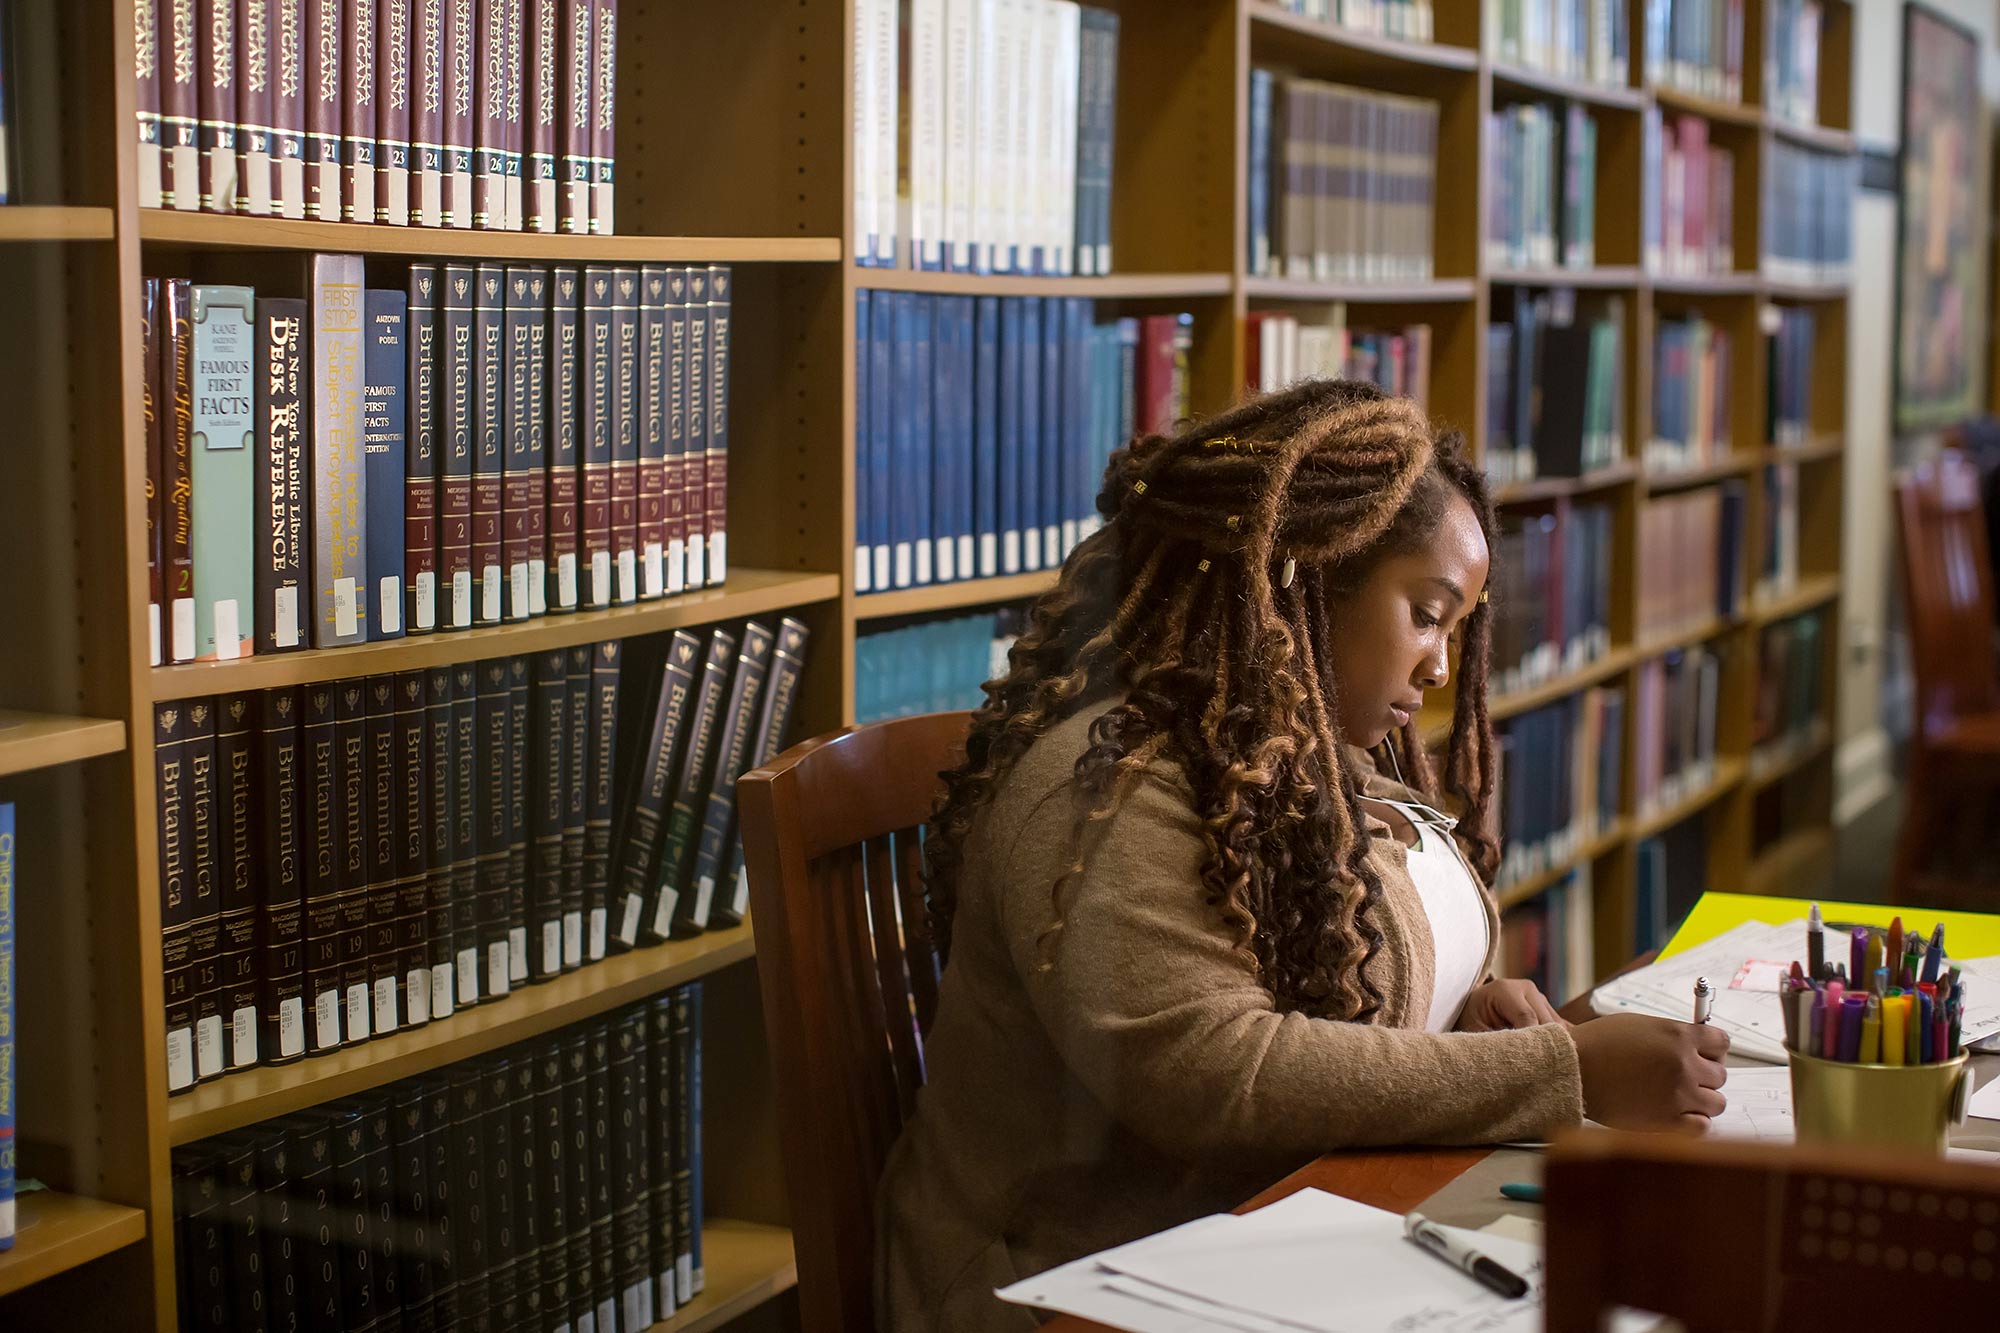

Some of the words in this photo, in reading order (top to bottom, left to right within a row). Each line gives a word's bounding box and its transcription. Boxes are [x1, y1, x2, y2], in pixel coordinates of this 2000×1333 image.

[283, 139, 298, 156] 20
[323, 143, 336, 158] 21
[357, 147, 371, 162] 22
[392, 150, 405, 165] 23
[426, 153, 438, 167] 24
[456, 155, 468, 170] 25
[490, 157, 502, 172] 26
[506, 160, 518, 175] 27
[541, 163, 554, 178] 28
[574, 165, 587, 179] 29
[323, 290, 358, 307] FIRST
[324, 309, 358, 326] STOP
[288, 318, 299, 352] The
[200, 360, 249, 374] FAMOUS
[270, 317, 290, 396] DESK
[207, 378, 242, 392] FIRST
[288, 356, 299, 396] New
[325, 339, 342, 419] Subject
[514, 324, 528, 454] Britannica
[530, 324, 545, 452] Britannica
[561, 324, 576, 450] Britannica
[594, 323, 608, 448] Britannica
[620, 322, 635, 446] Britannica
[650, 321, 664, 443] Britannica
[671, 321, 685, 441] Britannica
[690, 319, 705, 438] Britannica
[713, 317, 728, 435] Britannica
[364, 386, 397, 396] FAMOUS
[419, 324, 433, 460] Britannica
[455, 324, 469, 458] Britannica
[485, 324, 499, 457] Britannica
[200, 397, 250, 415] FACTS
[364, 402, 387, 412] FIRST
[288, 400, 300, 442] York
[364, 418, 390, 427] FACTS
[289, 446, 301, 500] Public
[270, 405, 290, 571] REFERENCE
[345, 472, 359, 528] Index
[171, 476, 192, 545] Reading
[563, 510, 570, 526] 6
[597, 507, 603, 523] 7
[623, 504, 630, 519] 8
[651, 501, 658, 517] 9
[671, 498, 681, 513] 10
[457, 522, 465, 538] 2
[488, 519, 494, 535] 3
[516, 517, 523, 532] 4
[533, 513, 540, 529] 5
[289, 504, 301, 569] Library
[347, 535, 360, 557] to
[177, 569, 189, 591] 2
[571, 691, 587, 814] Britannica
[599, 685, 616, 806] Britannica
[651, 683, 687, 798] Britannica
[512, 703, 527, 829] Britannica
[549, 698, 563, 820] Britannica
[433, 720, 449, 852] Britannica
[458, 716, 473, 846] Britannica
[490, 711, 505, 838] Britannica
[346, 735, 362, 873] Britannica
[376, 731, 394, 865] Britannica
[406, 726, 423, 860] Britannica
[232, 748, 249, 892] Britannica
[278, 744, 297, 886] Britannica
[315, 739, 331, 879] Britannica
[162, 759, 182, 910] Britannica
[194, 753, 212, 898] Britannica
[409, 921, 422, 939] 21
[436, 912, 449, 929] 22
[350, 935, 362, 953] 19
[378, 928, 393, 946] 20
[283, 949, 297, 968] 17
[320, 942, 333, 961] 18
[200, 965, 215, 985] 15
[236, 956, 251, 976] 16
[170, 975, 186, 995] 14
